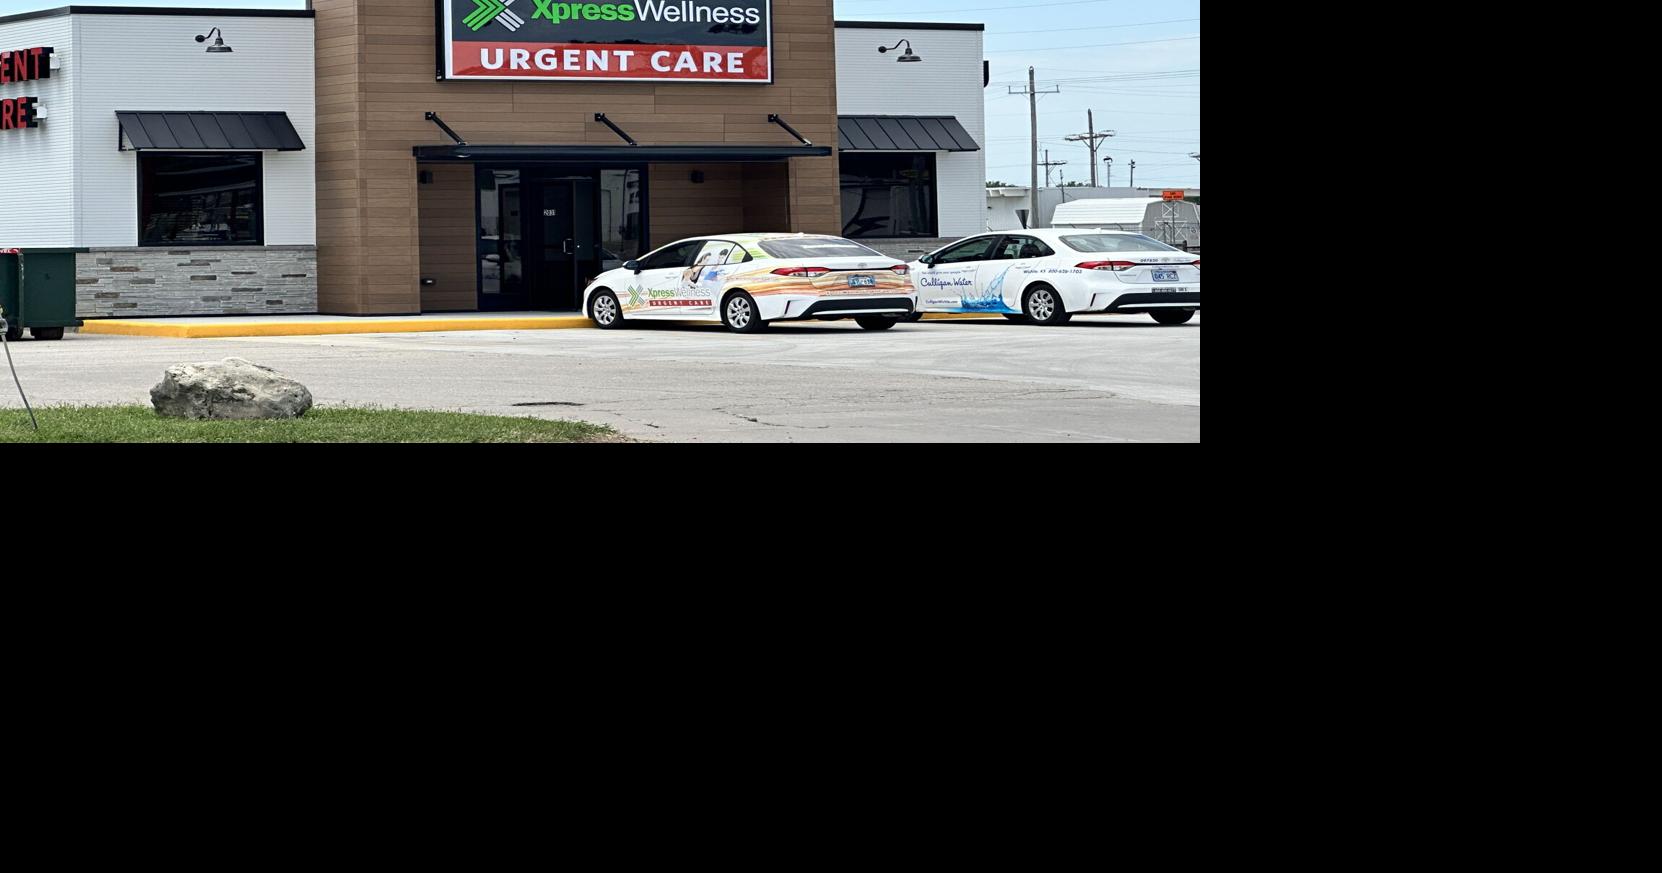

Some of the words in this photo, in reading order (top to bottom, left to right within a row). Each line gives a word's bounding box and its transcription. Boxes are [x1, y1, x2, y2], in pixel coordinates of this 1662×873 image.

[480, 48, 635, 72] URGENT
[650, 50, 744, 74] CARE
[921, 277, 953, 290] Culligan
[953, 277, 972, 286] Water
